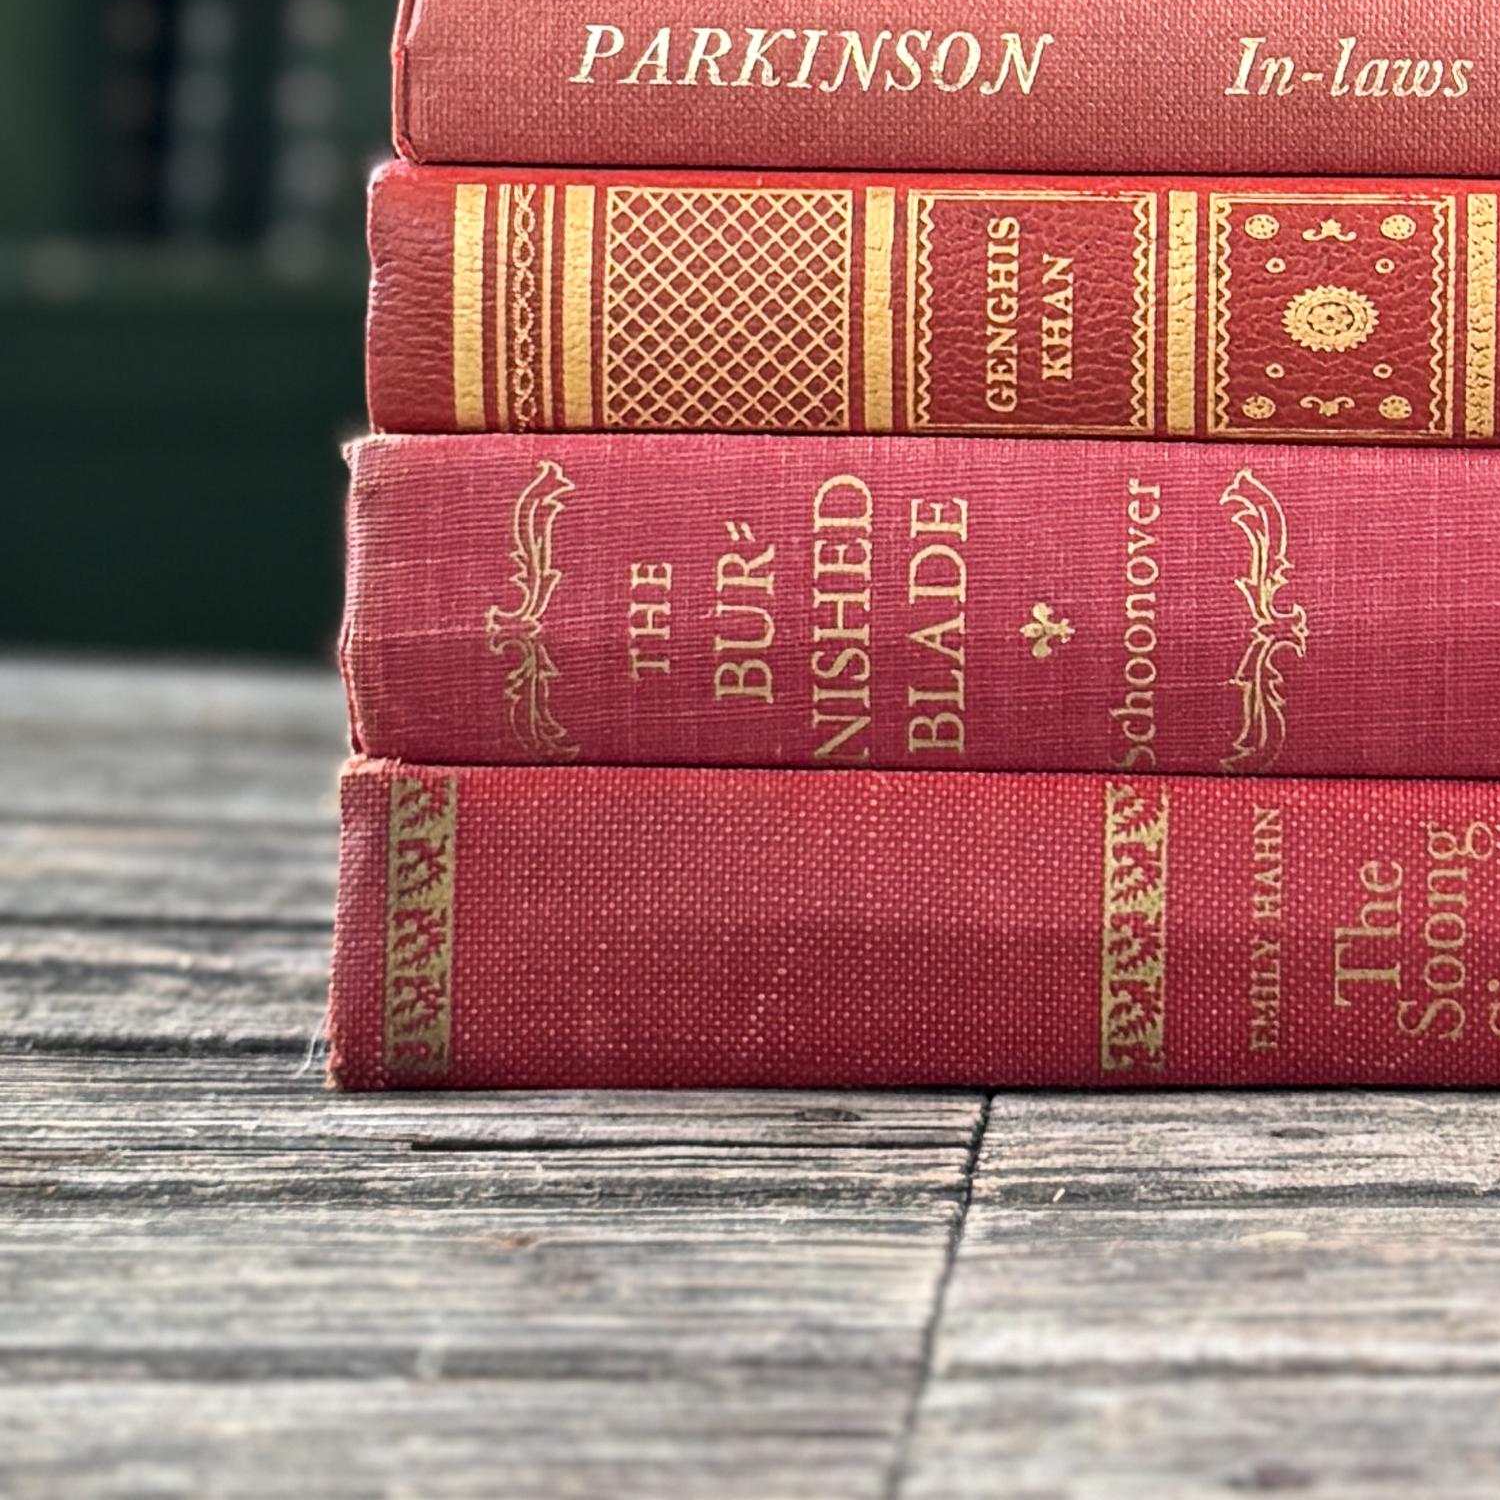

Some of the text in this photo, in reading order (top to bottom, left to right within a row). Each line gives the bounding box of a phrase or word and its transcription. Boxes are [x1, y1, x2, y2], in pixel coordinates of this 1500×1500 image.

[569, 24, 1054, 95] PARKINSON
[1225, 36, 1474, 99] In-laws
[986, 217, 1019, 412] GENGHIS
[1042, 253, 1074, 380] KHAN
[630, 562, 672, 679] THE
[811, 474, 872, 762] NISHED
[907, 497, 967, 753] BLADE
[1107, 478, 1160, 770] Schoonover
[1249, 803, 1283, 1051] EMILY HAHN
[1334, 860, 1403, 1006] The
[1397, 820, 1494, 1041] Soong
